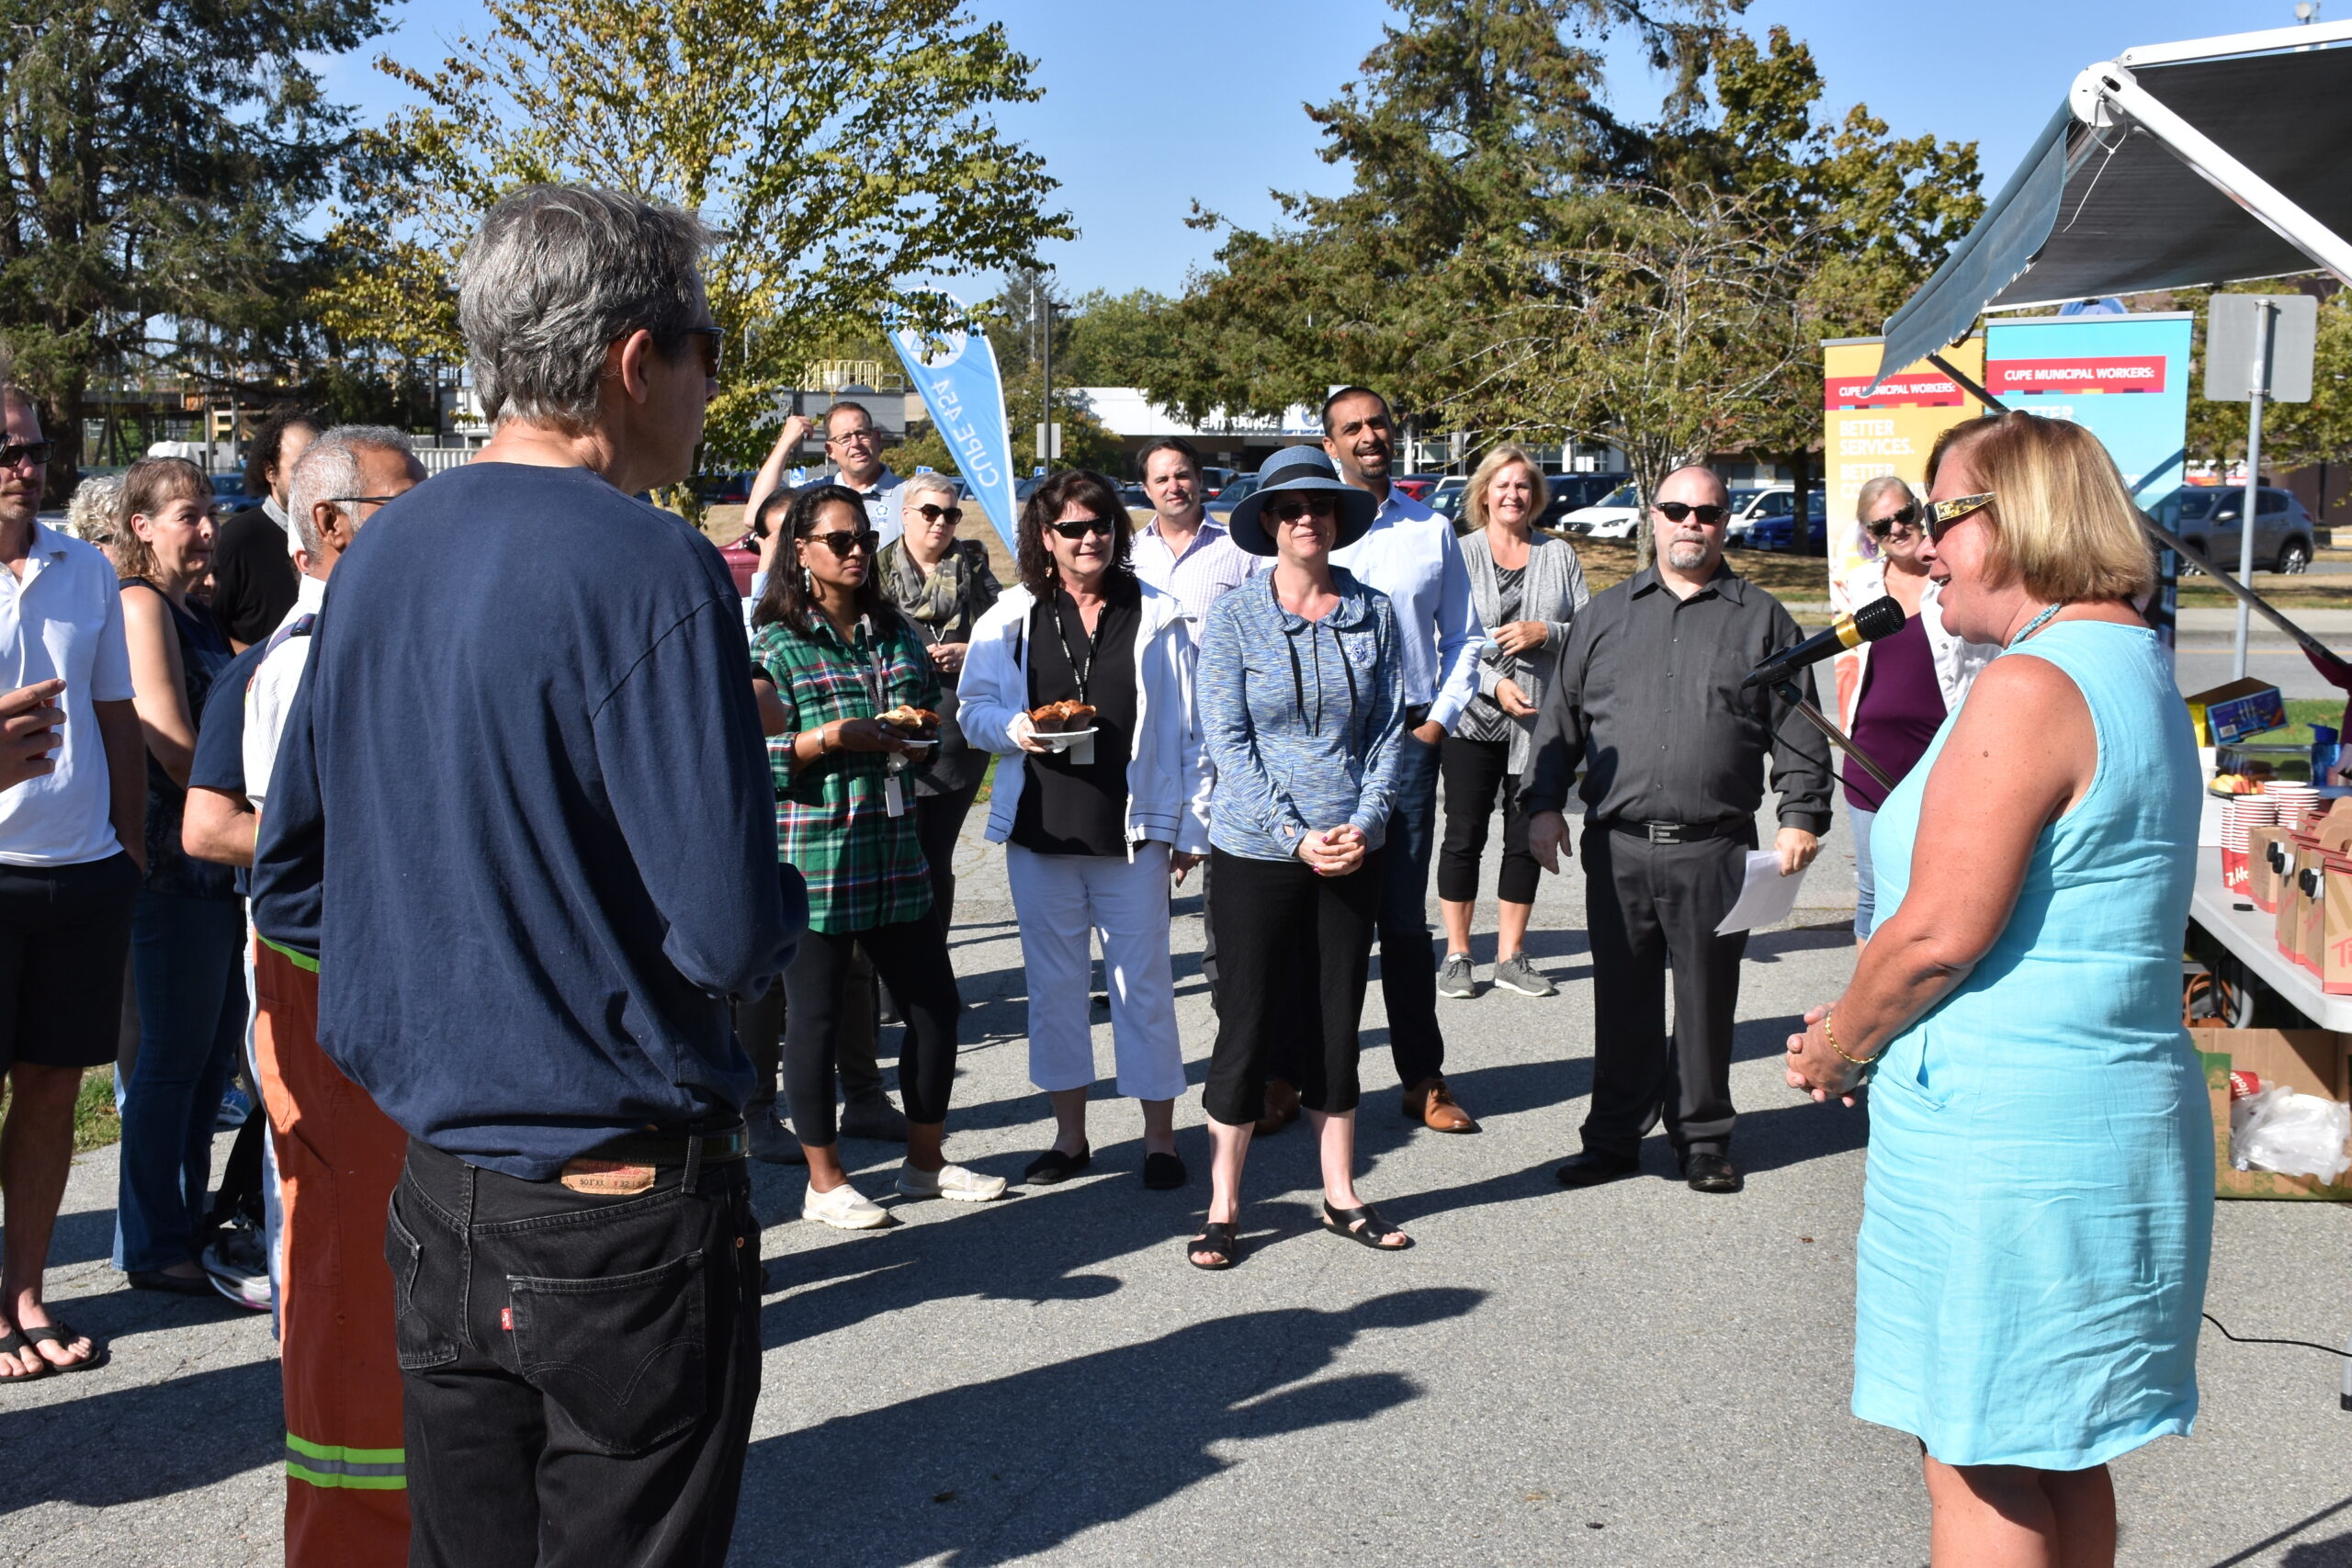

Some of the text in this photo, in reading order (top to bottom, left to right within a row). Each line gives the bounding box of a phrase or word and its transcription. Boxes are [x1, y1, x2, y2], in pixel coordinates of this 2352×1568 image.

[2005, 367, 2155, 380] CUPE MUNICIPAL WORKERS:
[1838, 386, 1861, 397] CUPE
[1909, 382, 1956, 394] WORKERS:
[2008, 404, 2074, 423] TTER
[1839, 419, 1894, 437] BETTER
[1839, 437, 1916, 457] SERVICES.
[1839, 463, 1895, 480] BETTER
